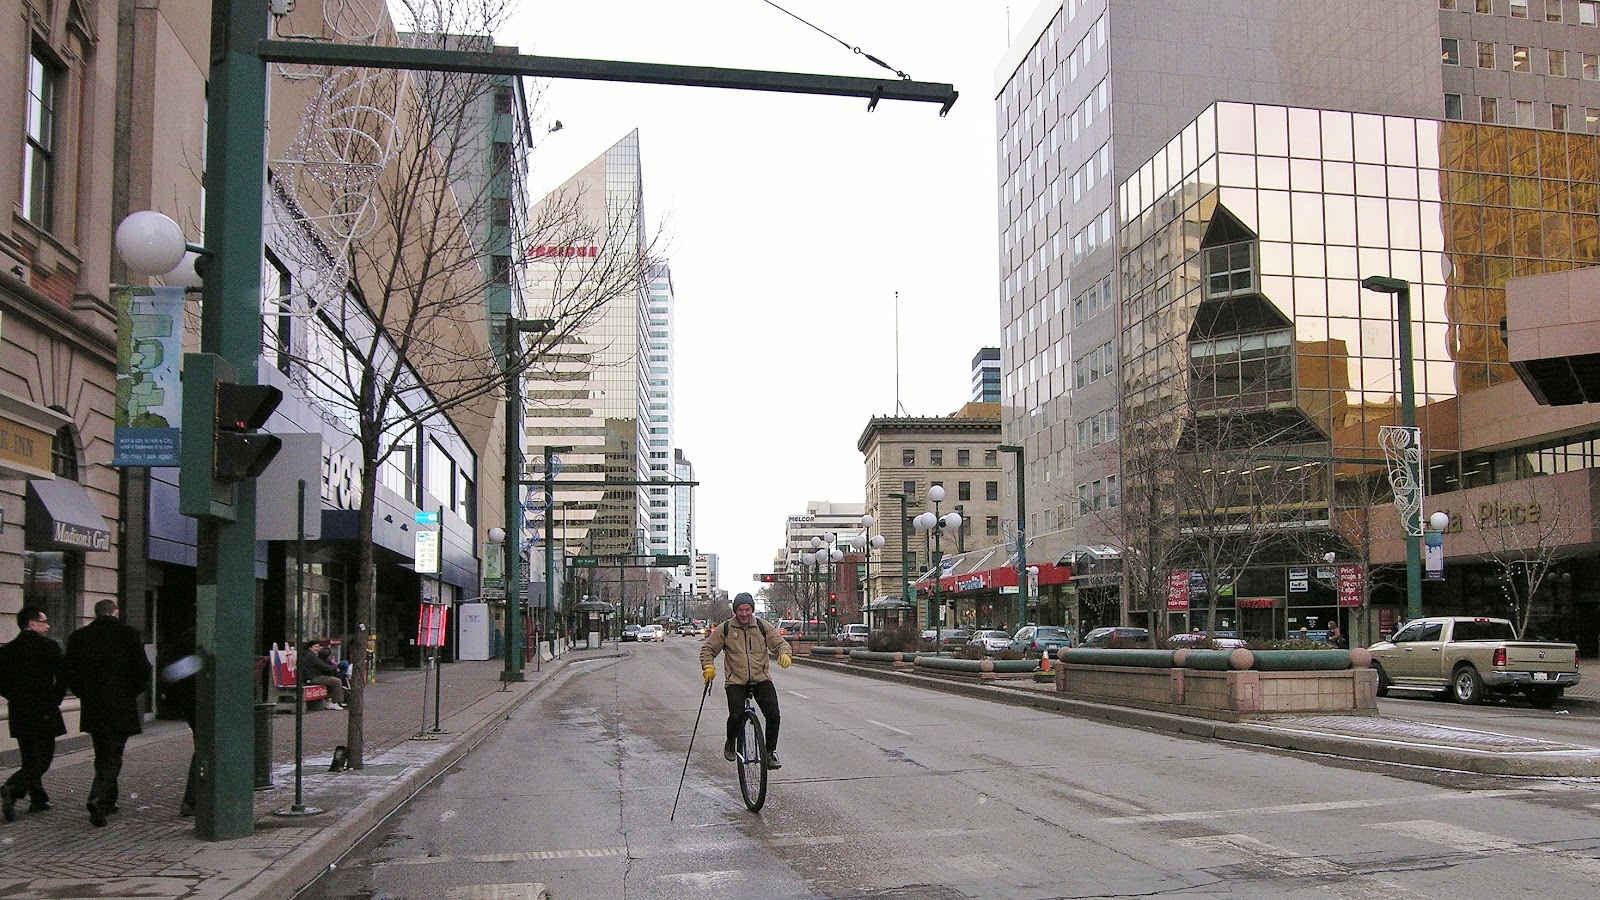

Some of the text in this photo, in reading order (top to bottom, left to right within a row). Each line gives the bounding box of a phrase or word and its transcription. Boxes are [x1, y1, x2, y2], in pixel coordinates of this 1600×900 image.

[14, 433, 33, 457] INN
[1478, 499, 1540, 528] Place
[55, 521, 110, 550] Madison's Grill
